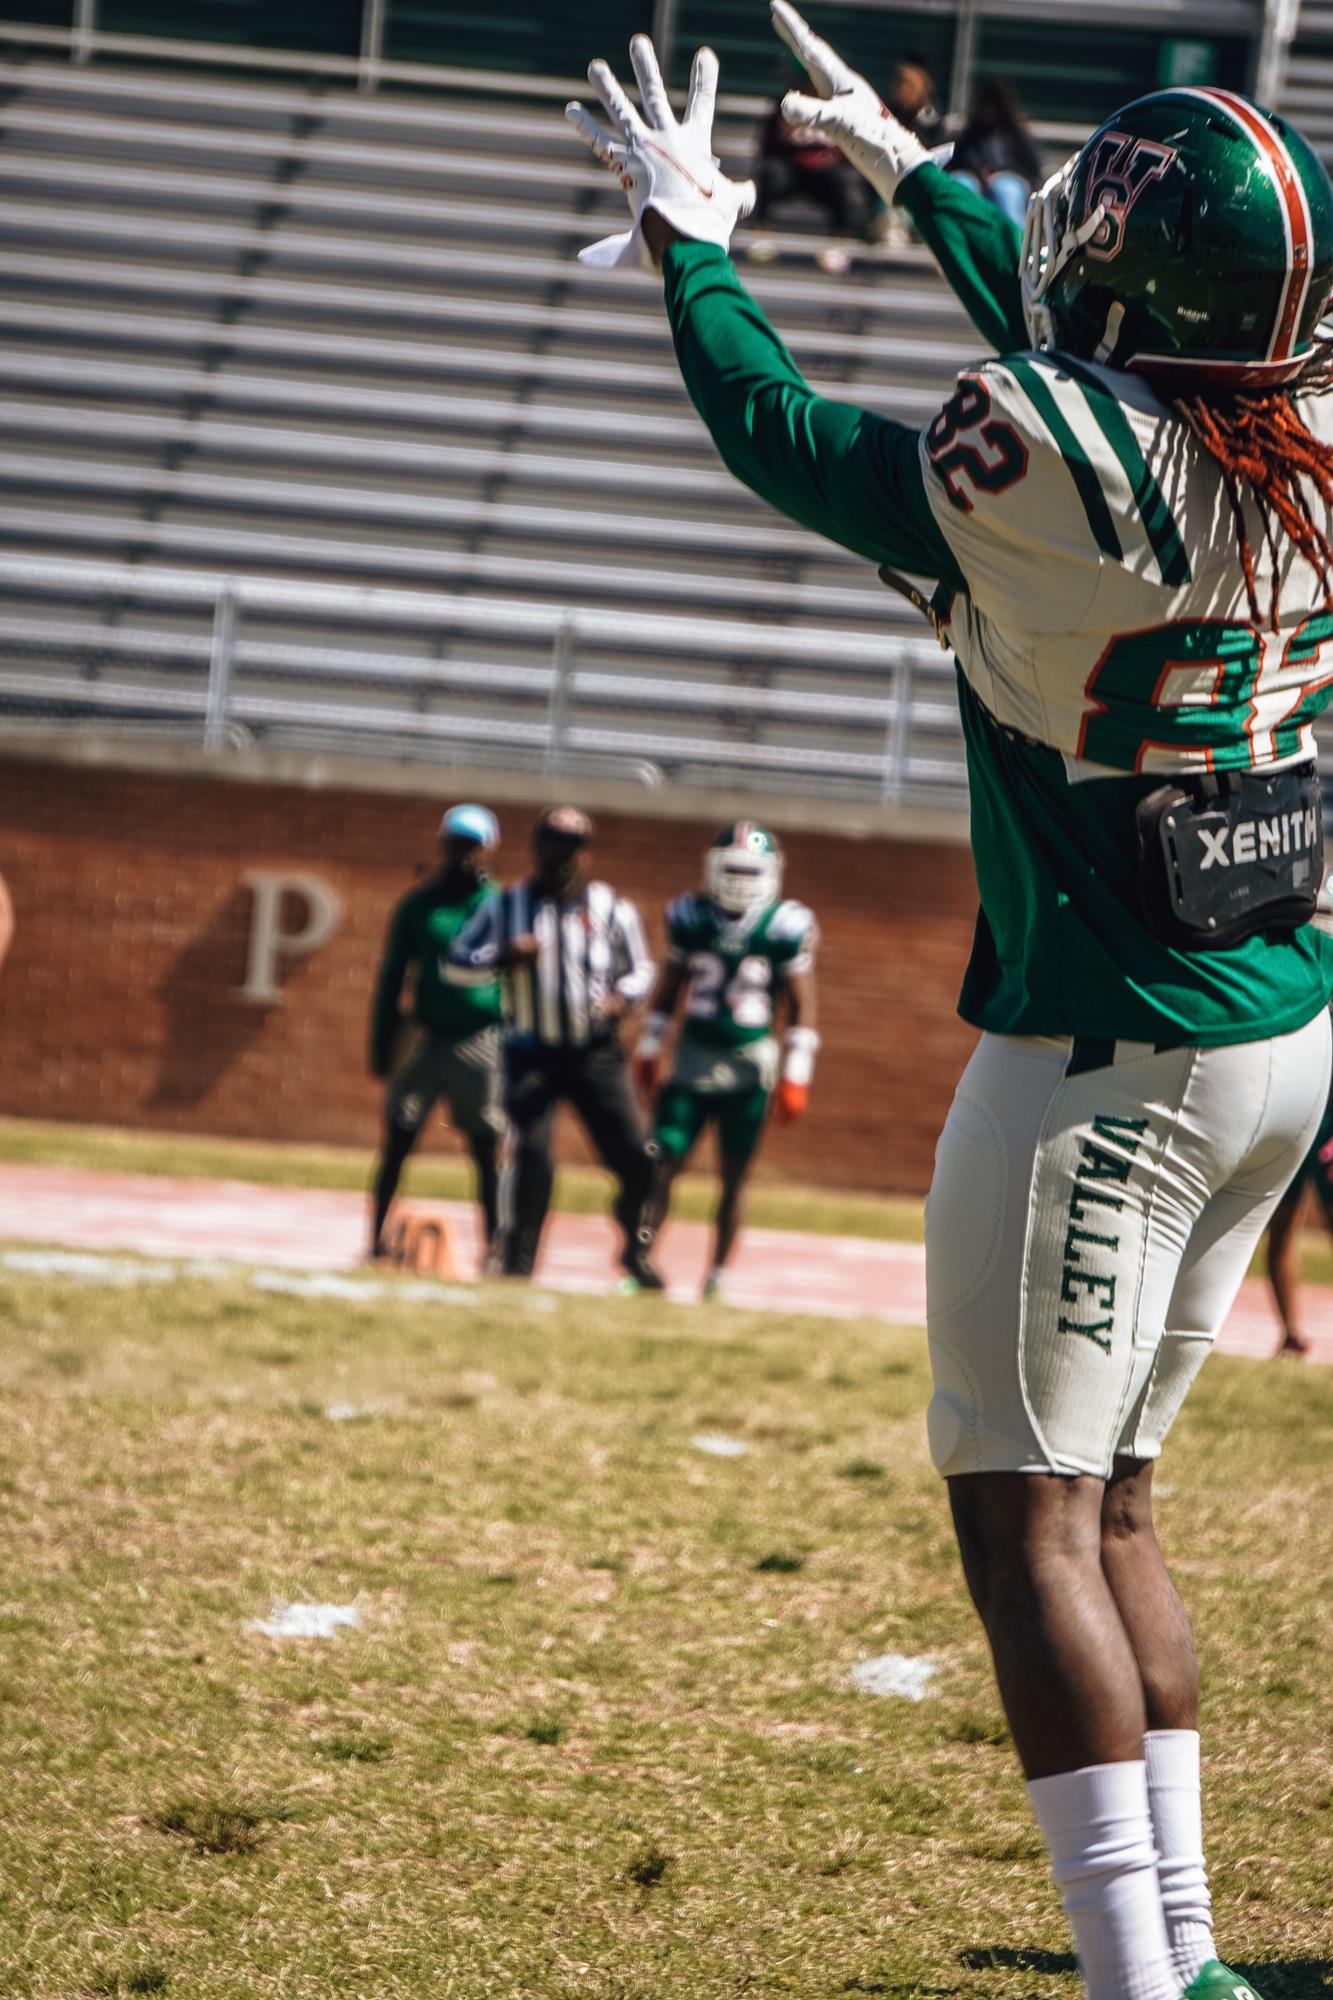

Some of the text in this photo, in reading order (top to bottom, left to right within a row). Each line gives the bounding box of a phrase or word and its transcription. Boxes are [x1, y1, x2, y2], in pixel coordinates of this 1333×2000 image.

[926, 372, 1030, 514] 82
[1197, 805, 1317, 870] XENITH
[238, 868, 343, 1006] P
[1057, 1114, 1150, 1356] VALLEY
